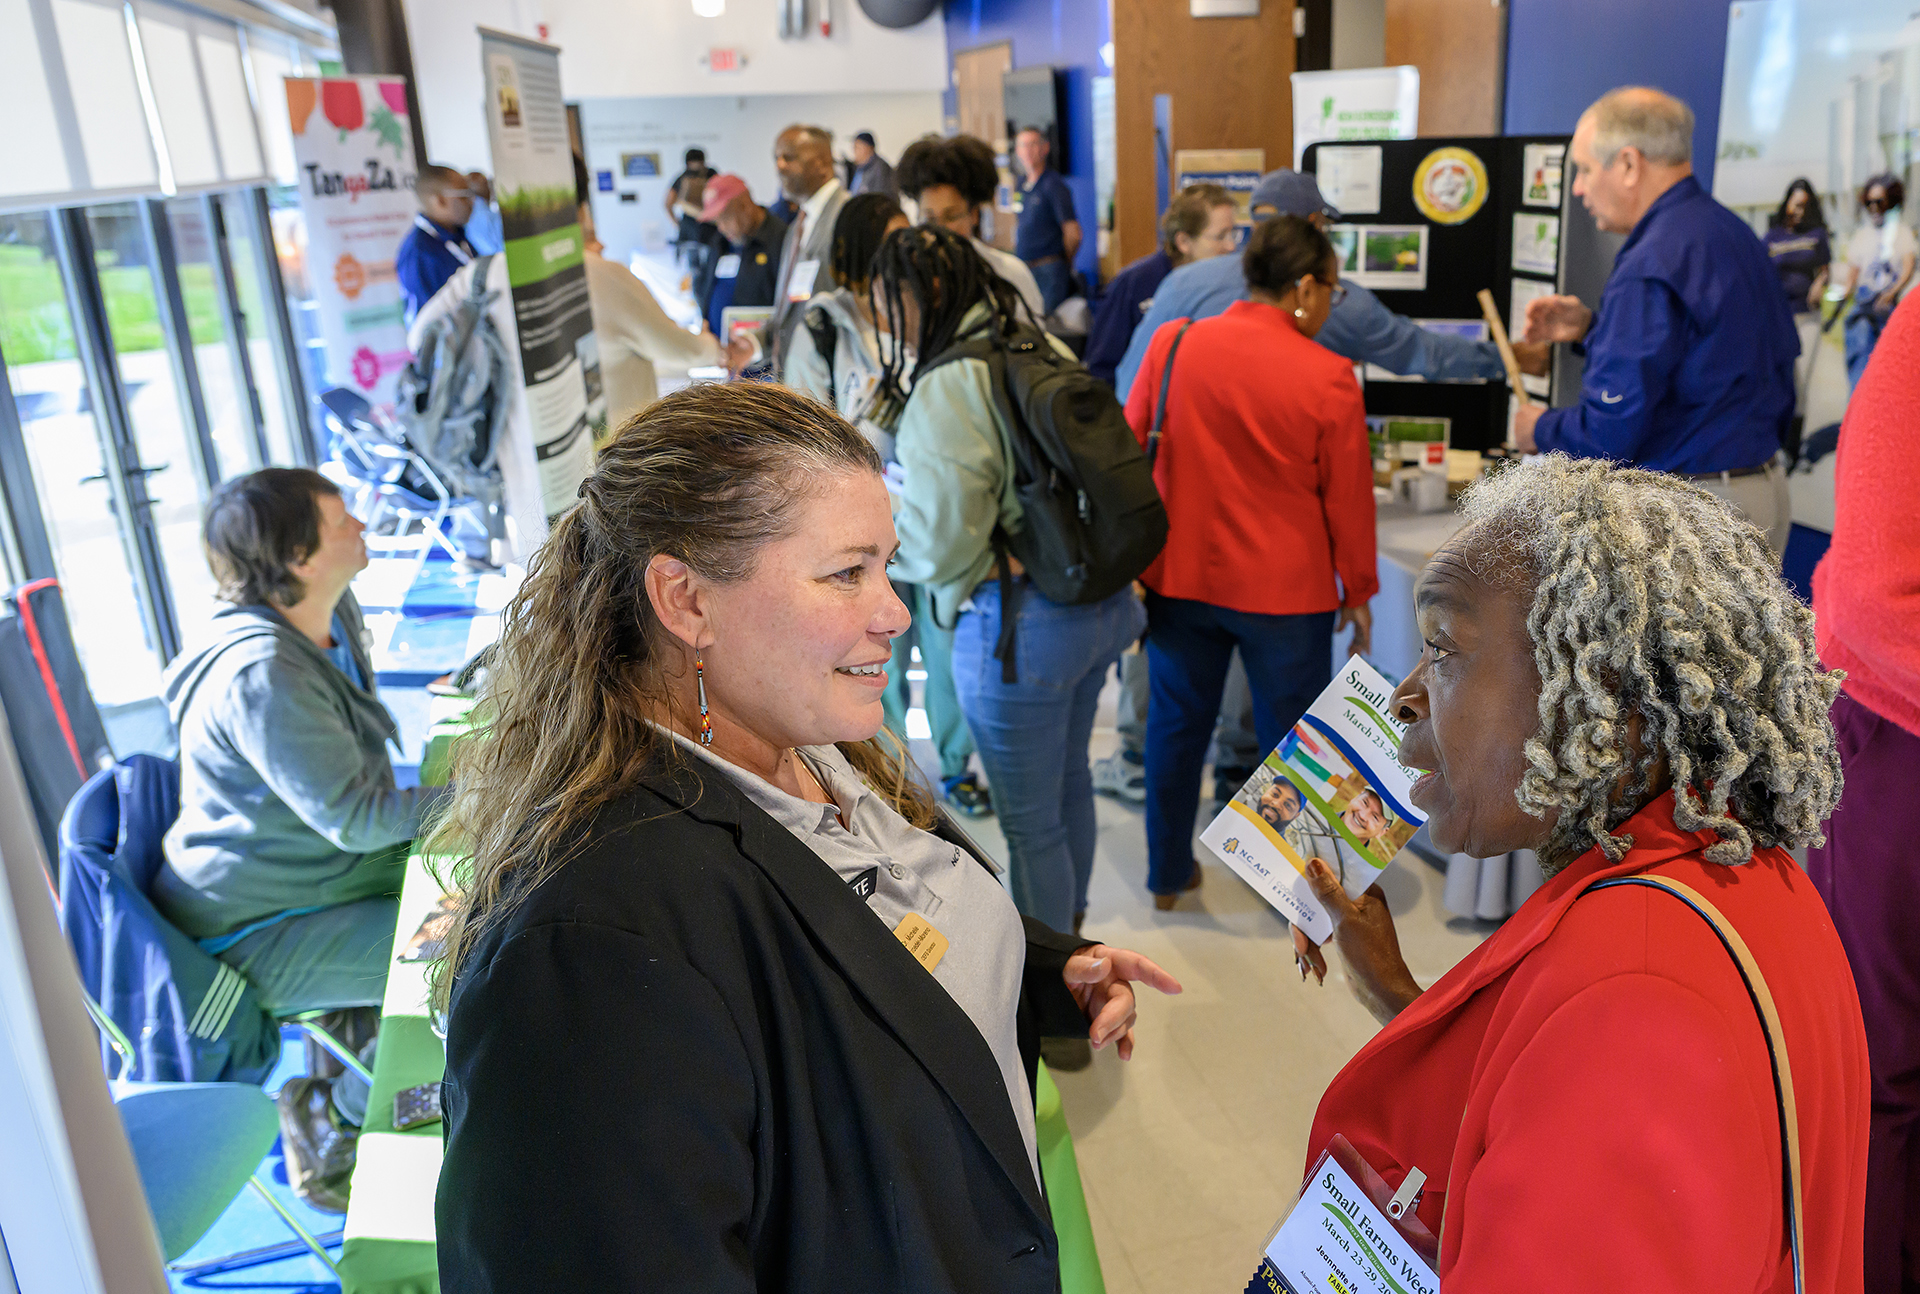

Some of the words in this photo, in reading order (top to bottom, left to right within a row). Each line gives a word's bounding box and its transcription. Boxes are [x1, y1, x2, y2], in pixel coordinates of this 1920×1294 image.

[1346, 670, 1386, 709] Small
[1343, 709, 1372, 738] March
[1254, 863, 1271, 877] A&T
[1272, 886, 1313, 922] EXTENSION
[1276, 881, 1316, 916] COOPERATIVE
[1321, 1217, 1351, 1253] March
[1322, 1173, 1360, 1220] Small
[1358, 1215, 1399, 1266] Farms
[1315, 1245, 1349, 1284] Jeannette
